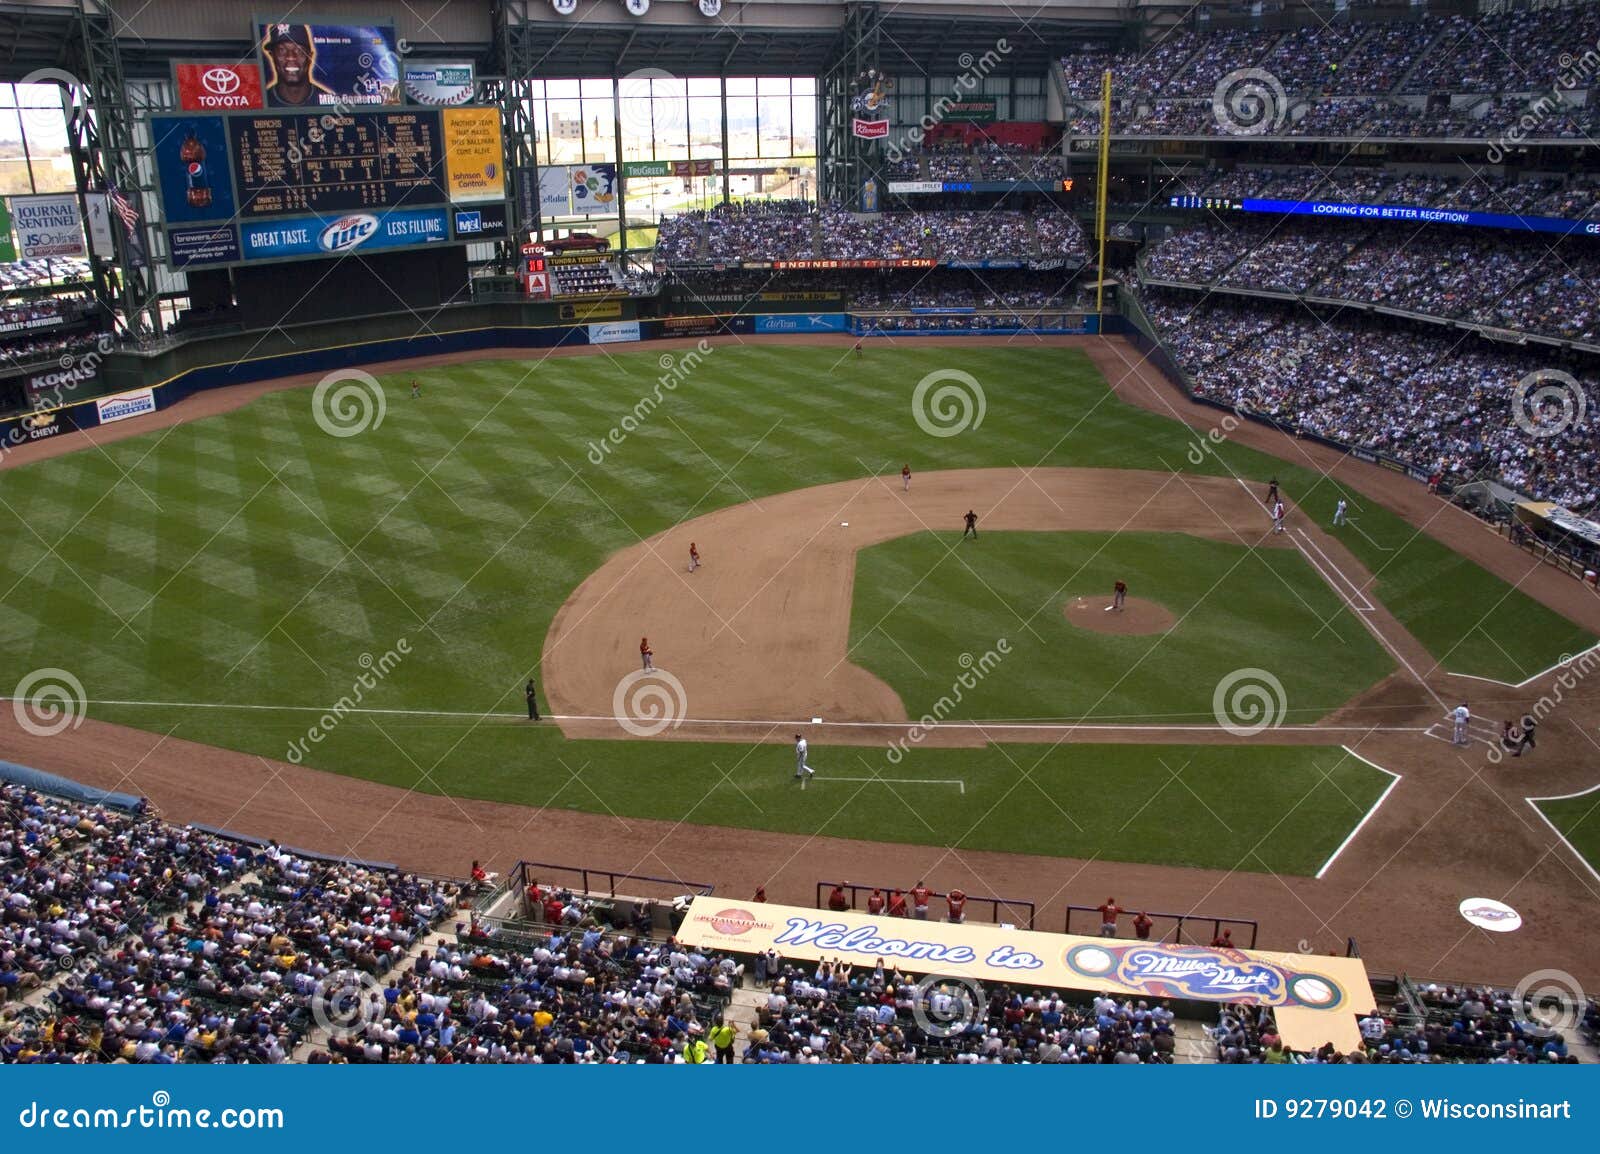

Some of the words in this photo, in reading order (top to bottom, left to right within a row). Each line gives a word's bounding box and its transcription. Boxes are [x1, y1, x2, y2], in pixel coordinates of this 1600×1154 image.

[198, 96, 249, 106] TOYOTA
[319, 94, 341, 105] Mike
[453, 172, 481, 180] Johnson
[458, 180, 488, 188] Controls
[18, 205, 75, 219] JOURNAL
[1313, 205, 1357, 215] LOOKING
[1359, 207, 1380, 216] FOR
[1382, 208, 1418, 219] BETTER
[18, 216, 77, 229] SENTINEL
[387, 220, 408, 236] LESS
[482, 221, 503, 229] BANK
[25, 232, 80, 247] JSOnline
[176, 230, 230, 243] brewers.com
[251, 231, 279, 248] GREAT
[281, 228, 311, 246] TASTE.
[522, 246, 546, 254] CITGO
[550, 257, 577, 265] TUNDRA
[30, 425, 59, 439] CHEVY
[774, 917, 976, 963] Welcome
[985, 945, 1043, 969] to
[1134, 953, 1219, 975] Miller
[1205, 966, 1270, 986] Park
